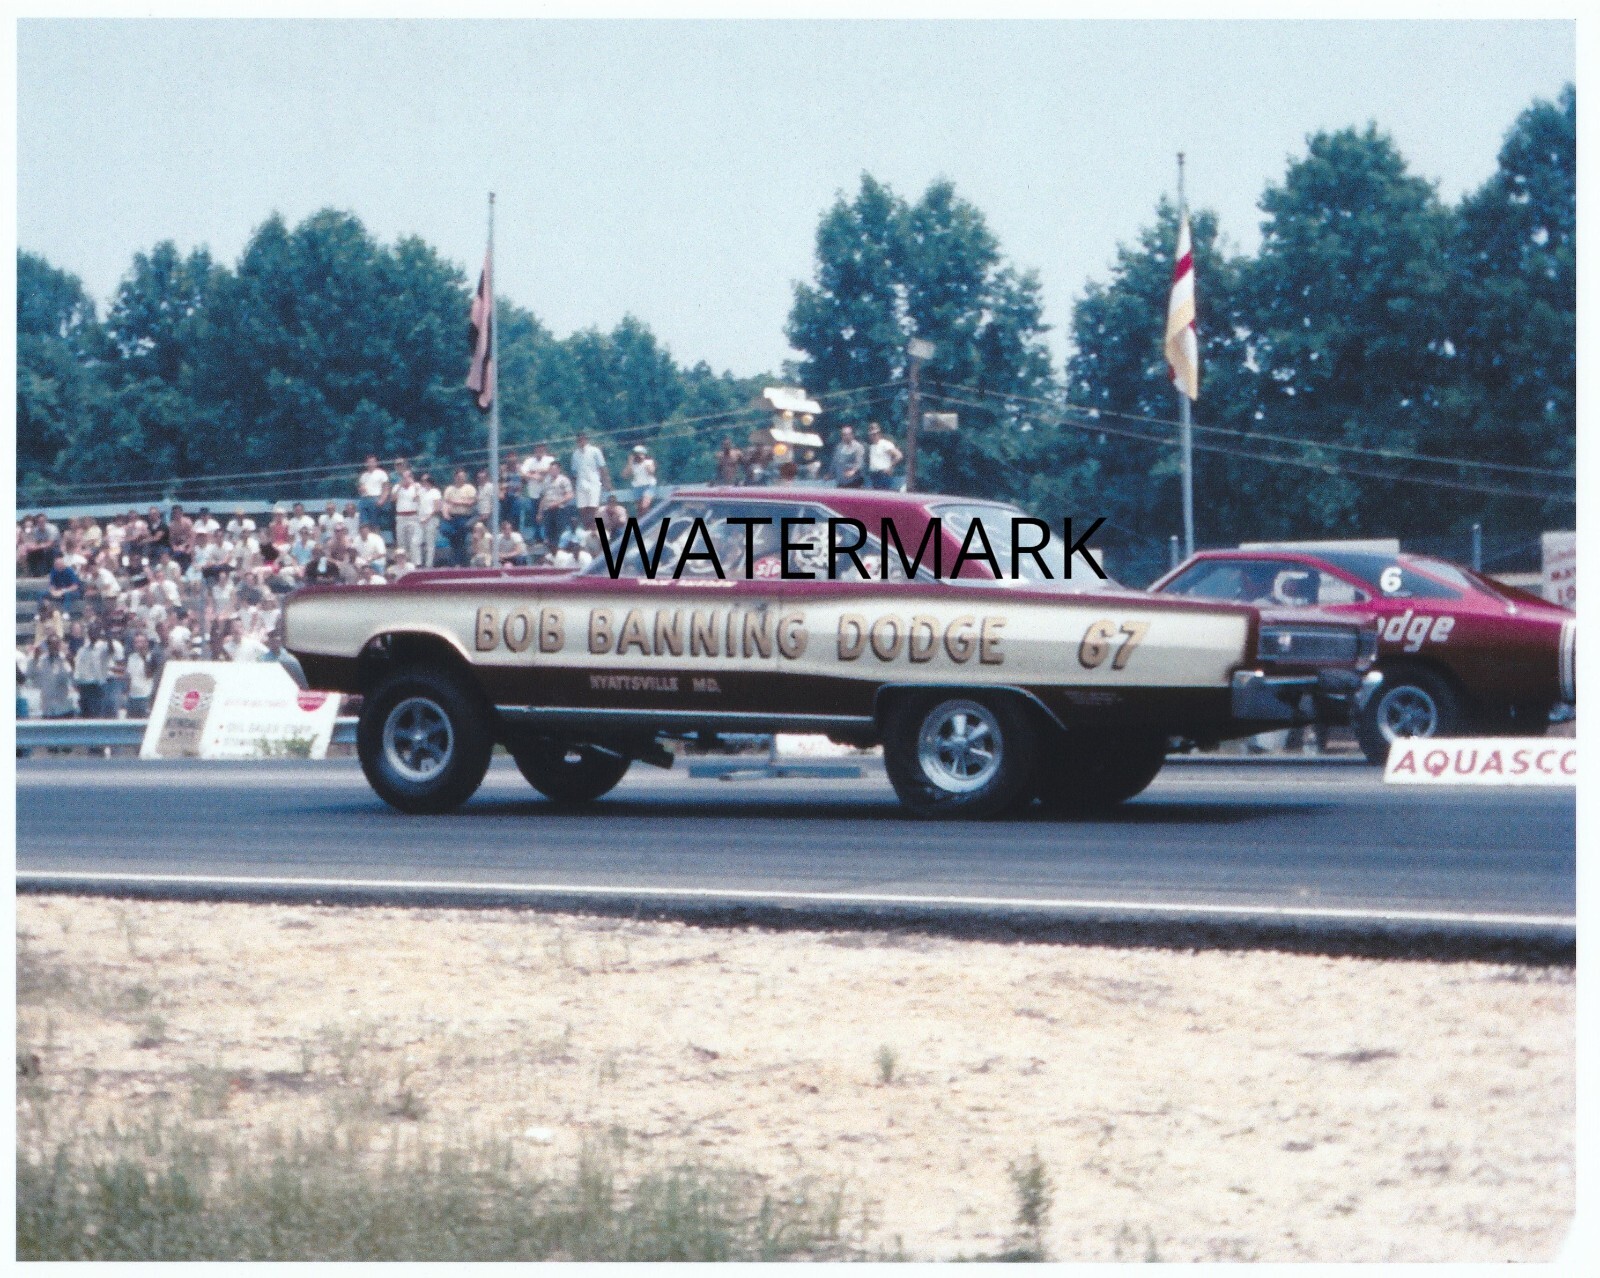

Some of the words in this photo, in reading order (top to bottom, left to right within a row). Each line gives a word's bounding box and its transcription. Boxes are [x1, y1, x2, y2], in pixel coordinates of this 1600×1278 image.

[1380, 566, 1402, 593] 6
[476, 607, 565, 653] BOB
[588, 608, 809, 660] BANNING
[837, 613, 1006, 665] DODGE
[1077, 620, 1149, 670] 67
[589, 675, 679, 692] HYATTSVILLE
